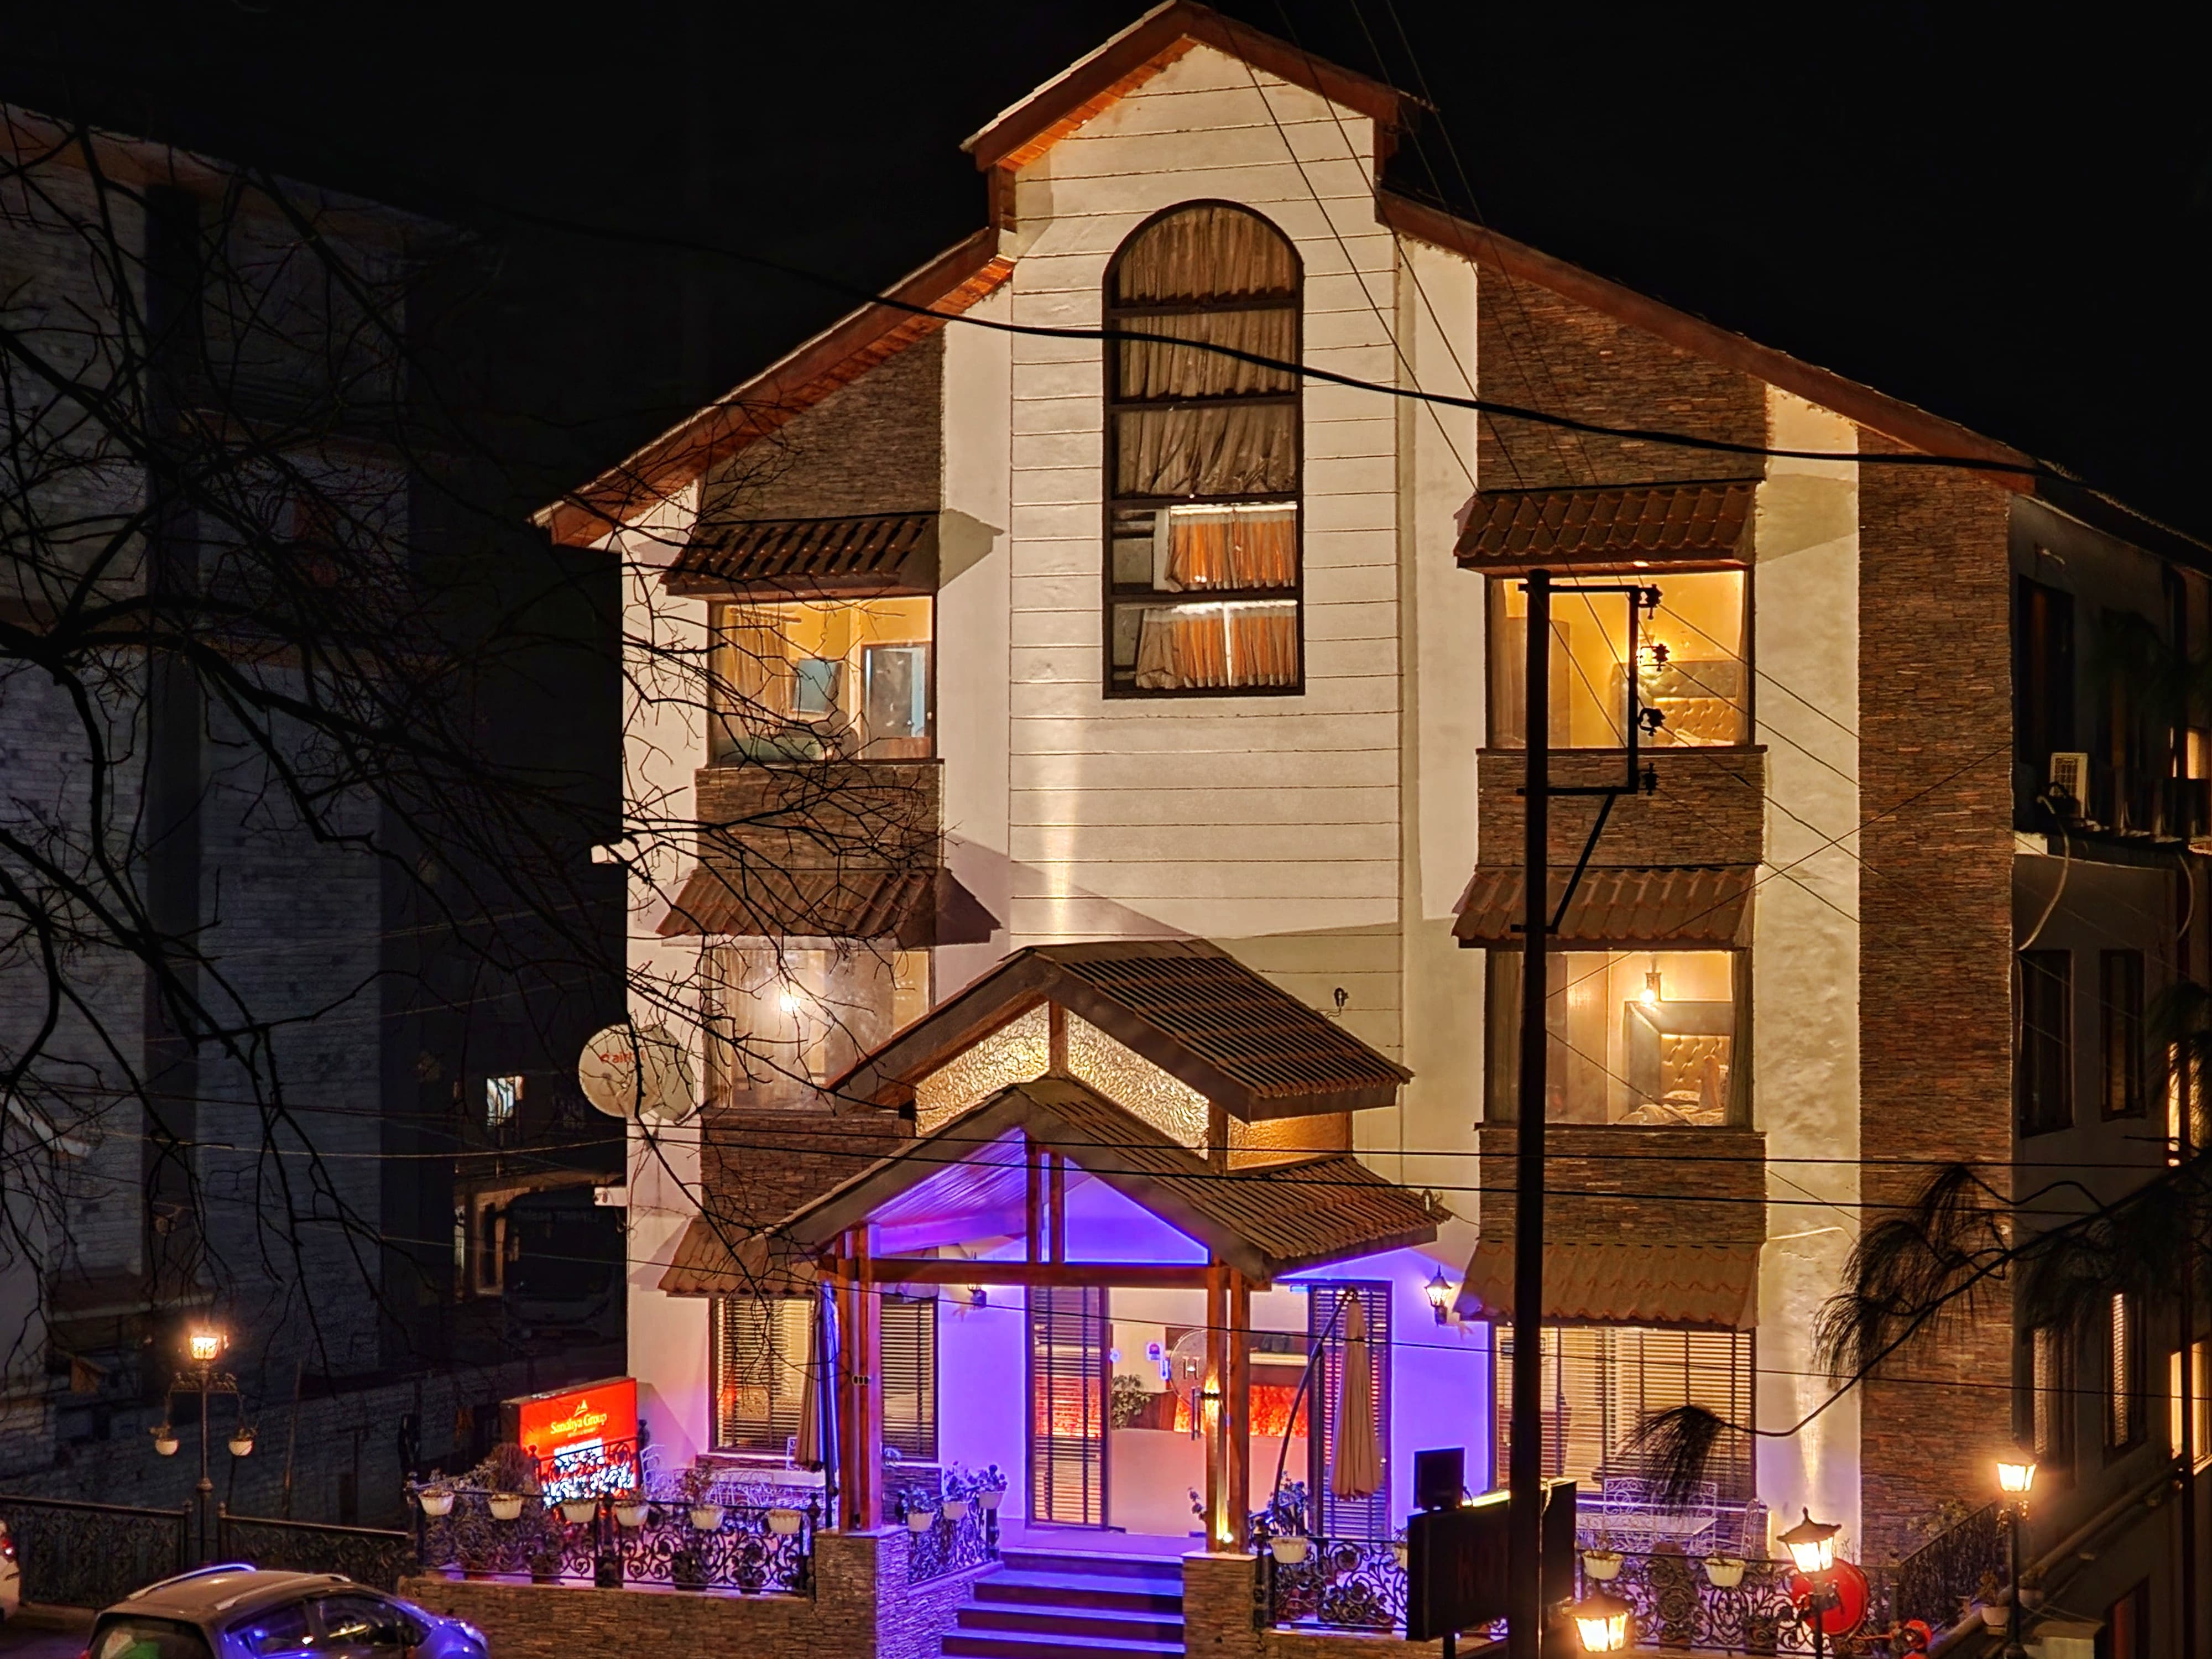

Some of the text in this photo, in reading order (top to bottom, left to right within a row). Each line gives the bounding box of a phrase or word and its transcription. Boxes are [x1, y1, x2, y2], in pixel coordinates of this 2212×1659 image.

[613, 1050, 646, 1063] airtl
[551, 1418, 583, 1434] Sandhya
[583, 1412, 607, 1426] Group
